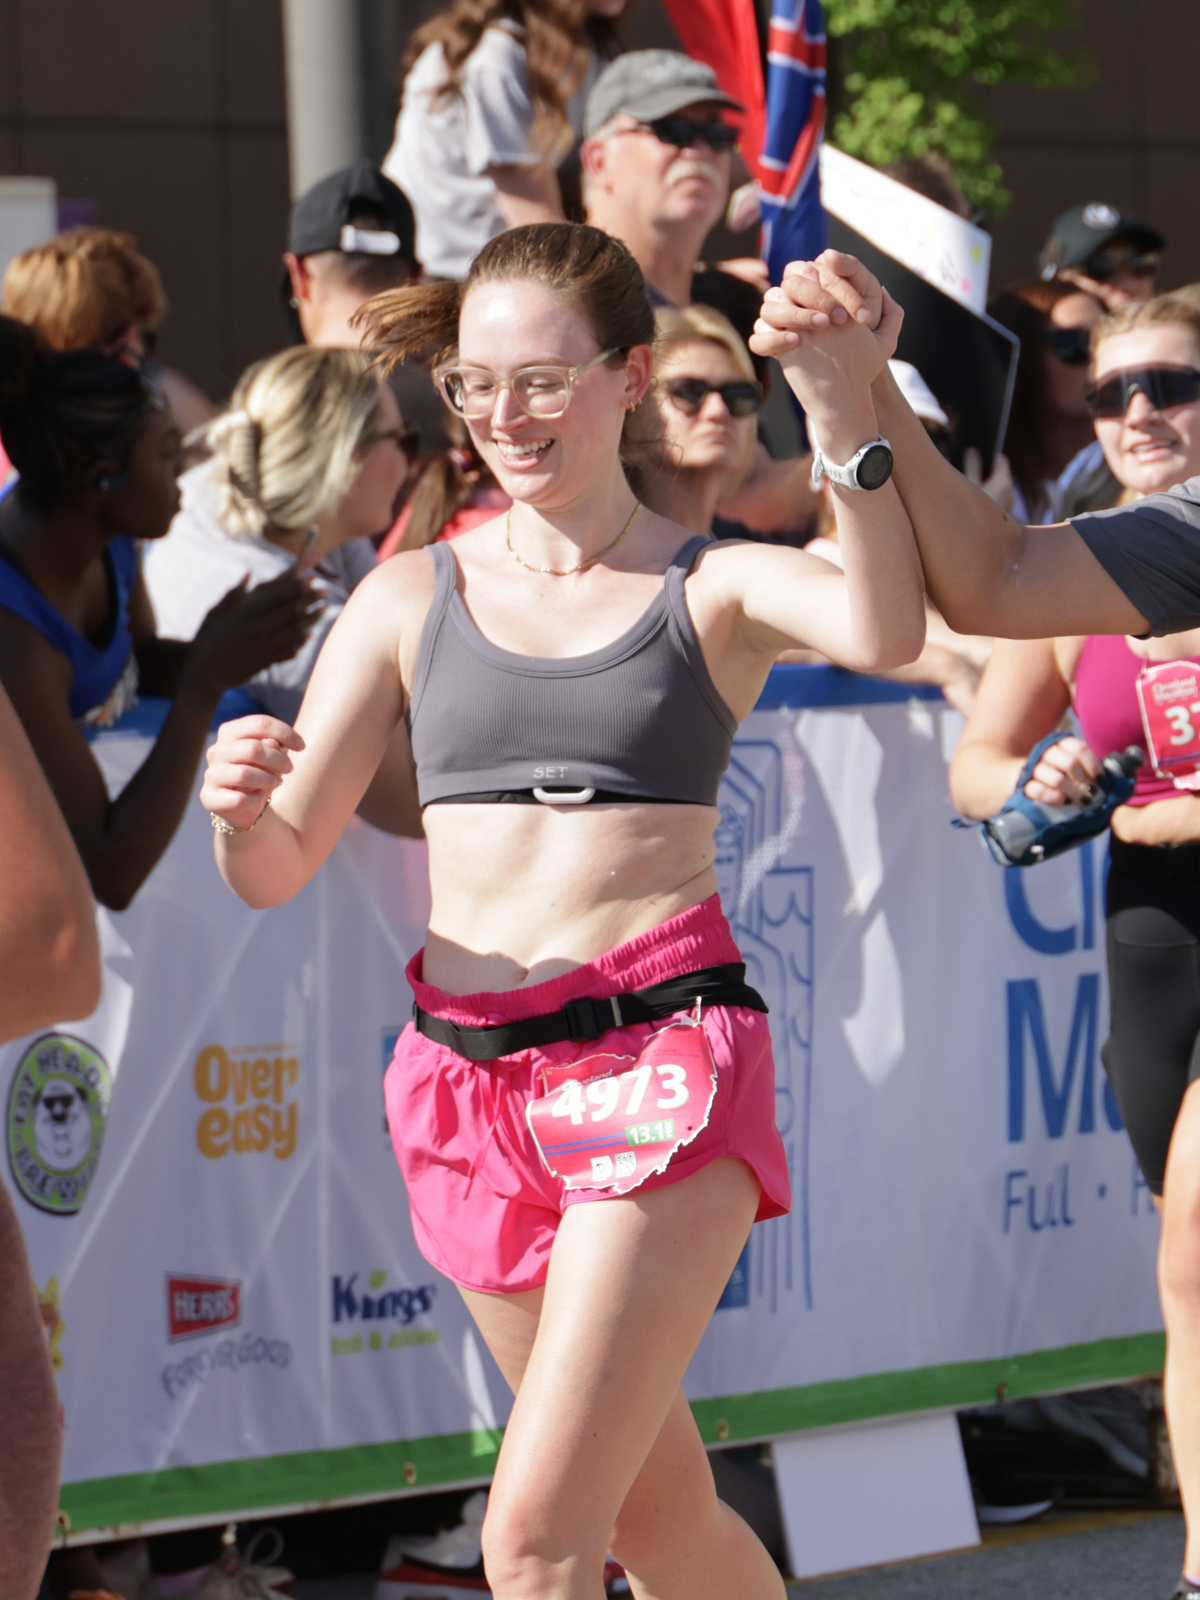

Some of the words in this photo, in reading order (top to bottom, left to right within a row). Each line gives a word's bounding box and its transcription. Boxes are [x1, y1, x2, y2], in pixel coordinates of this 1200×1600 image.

[533, 766, 569, 779] SET
[195, 1045, 299, 1105] Over
[551, 1064, 690, 1125] 4973
[197, 1100, 299, 1160] easy
[629, 1122, 664, 1144] 13.1
